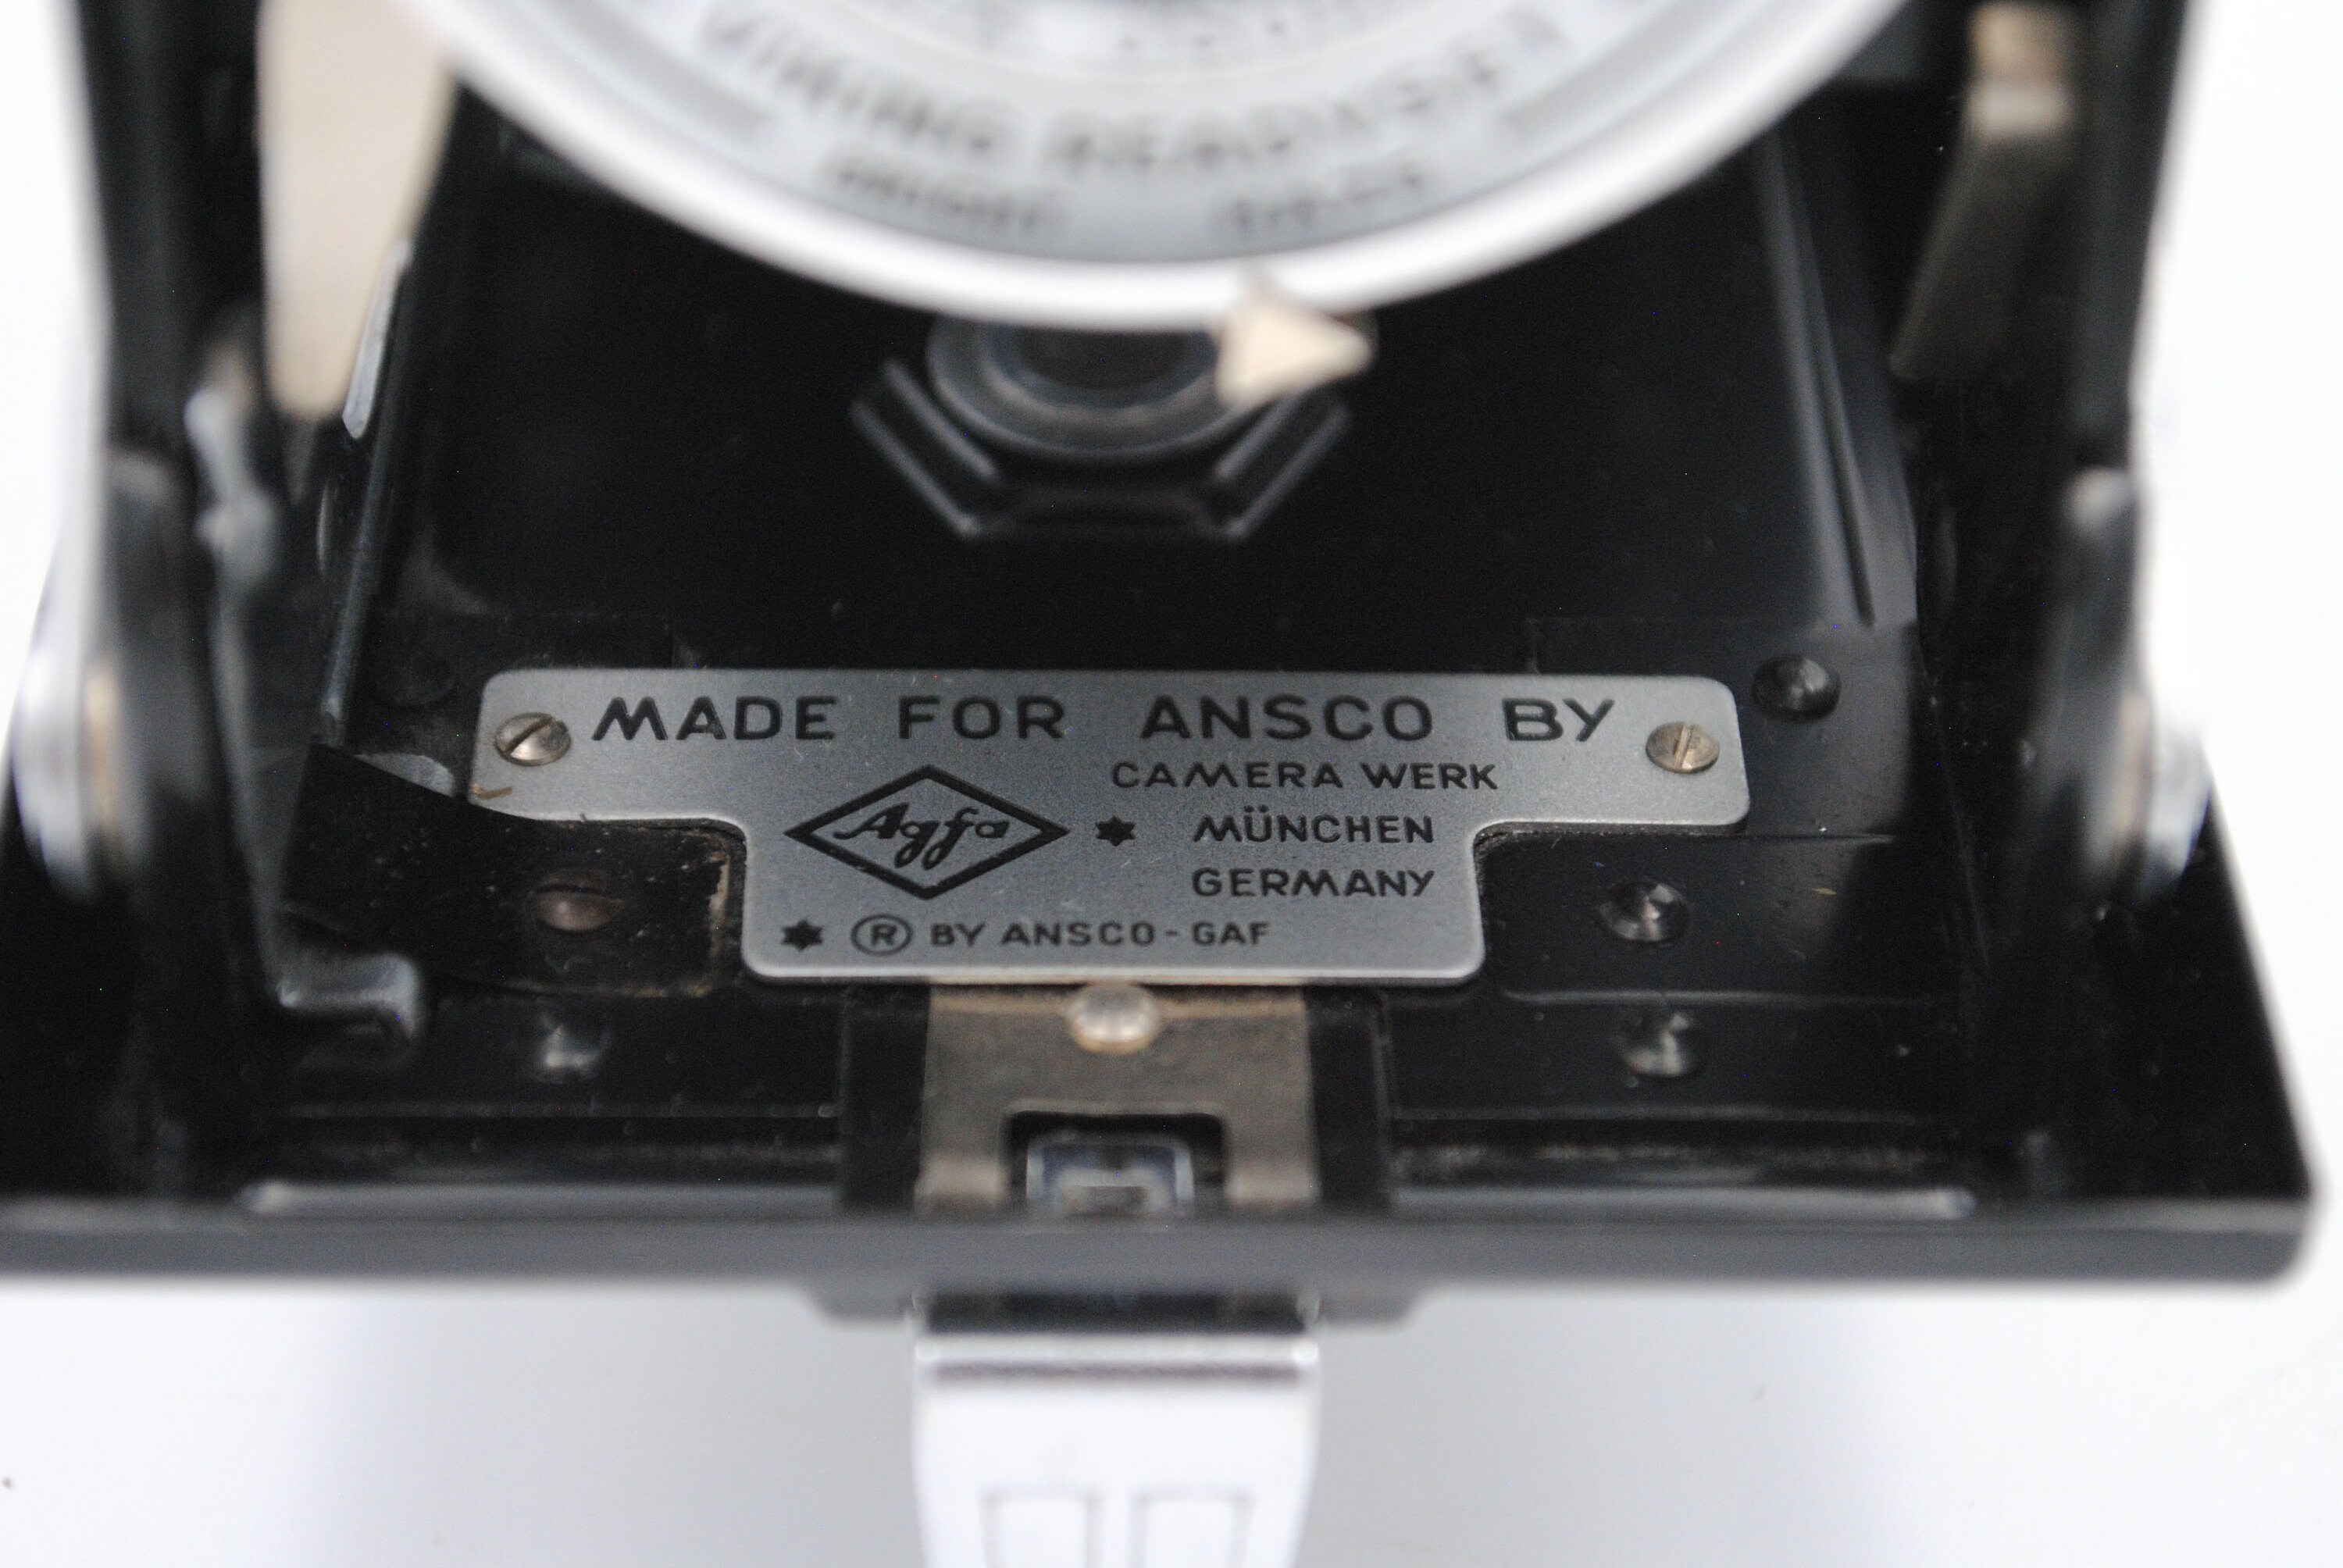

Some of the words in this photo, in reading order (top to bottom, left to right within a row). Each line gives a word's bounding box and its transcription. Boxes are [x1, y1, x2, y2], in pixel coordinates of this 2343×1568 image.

[591, 696, 836, 741] MADE
[899, 697, 1065, 740] FOR
[1140, 696, 1434, 741] ANSCO
[1503, 697, 1614, 743] BY
[1111, 763, 1343, 789] CAMERA
[1361, 764, 1498, 790] WERK
[833, 804, 1011, 870] Agfa
[1193, 807, 1435, 845] MÜNCHEN
[1192, 869, 1435, 898] GERMANY
[930, 924, 981, 947] BY
